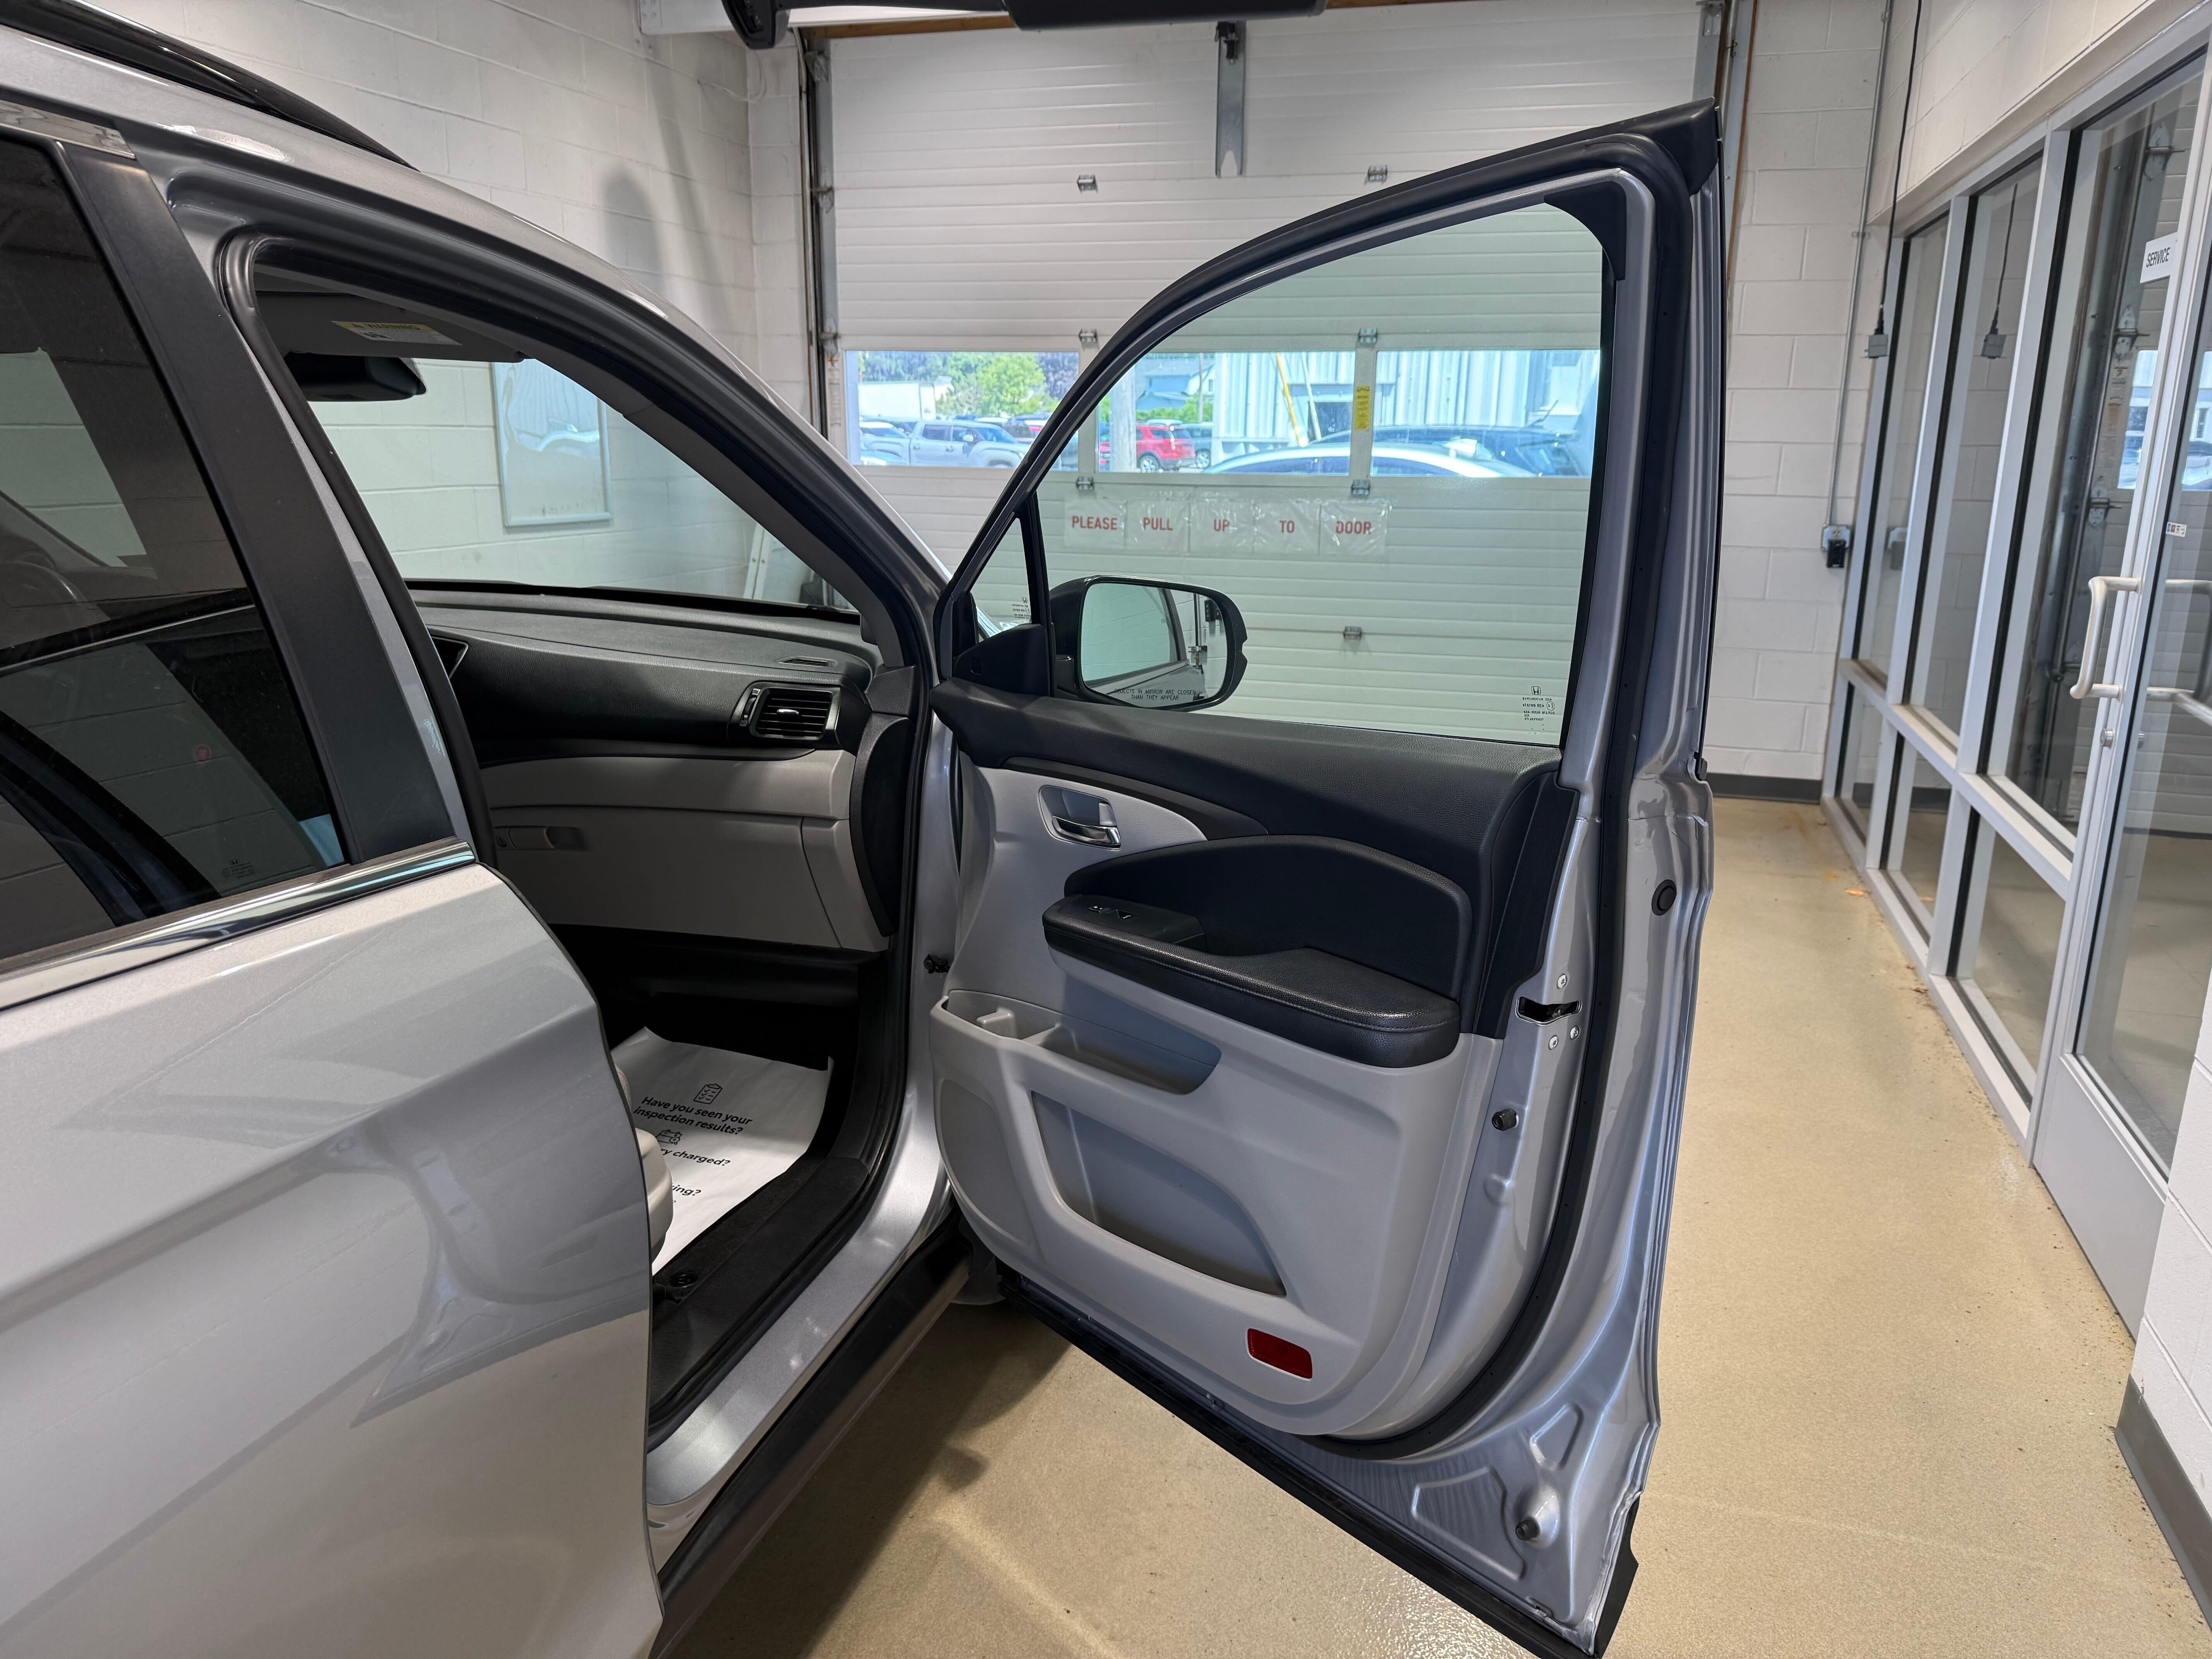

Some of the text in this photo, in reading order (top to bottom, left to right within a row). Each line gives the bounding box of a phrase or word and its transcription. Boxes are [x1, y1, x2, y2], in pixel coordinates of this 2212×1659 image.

[2146, 247, 2171, 268] SERVICE
[1072, 516, 1372, 534] PLEASE PULL UP TO DOOR
[634, 1106, 744, 1135] inspection results?
[641, 1096, 753, 1124] Have you seen your
[673, 1151, 731, 1166] charged?
